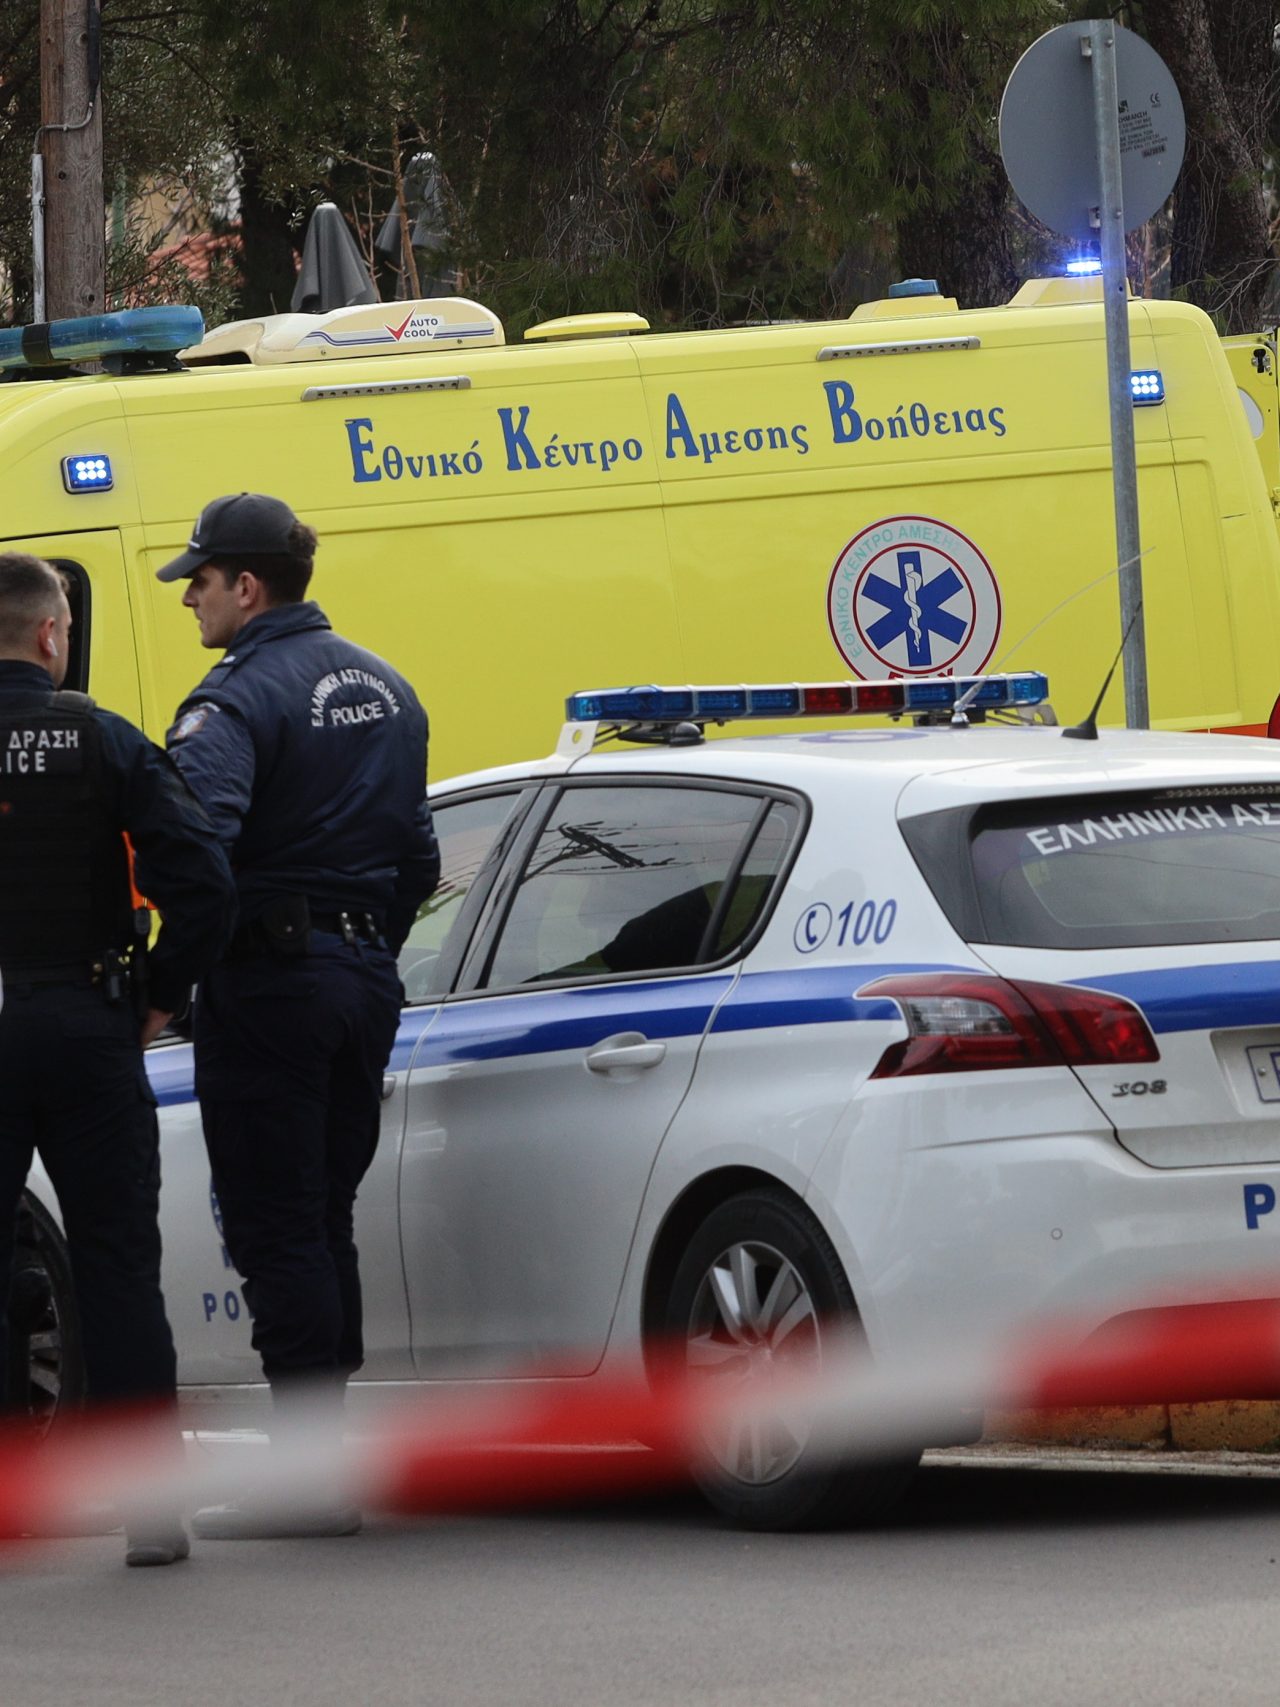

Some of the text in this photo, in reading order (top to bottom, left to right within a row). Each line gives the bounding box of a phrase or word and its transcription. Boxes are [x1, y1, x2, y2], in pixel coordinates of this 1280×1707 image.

[404, 329, 433, 338] COOL
[410, 318, 438, 327] AUTO
[344, 380, 1006, 483] Εθνικό Κέντρο Αμεσης Βοήθειας
[843, 528, 894, 583] ΚΕΝΤΡΟ
[330, 701, 384, 726] POLICE
[8, 730, 79, 749] ΔΡΑΣΗ
[0, 751, 46, 774] ICE
[1026, 805, 1228, 856] ΕΛΛΗΝΙΚΗ
[837, 899, 897, 946] 100
[1111, 1079, 1168, 1097] 308
